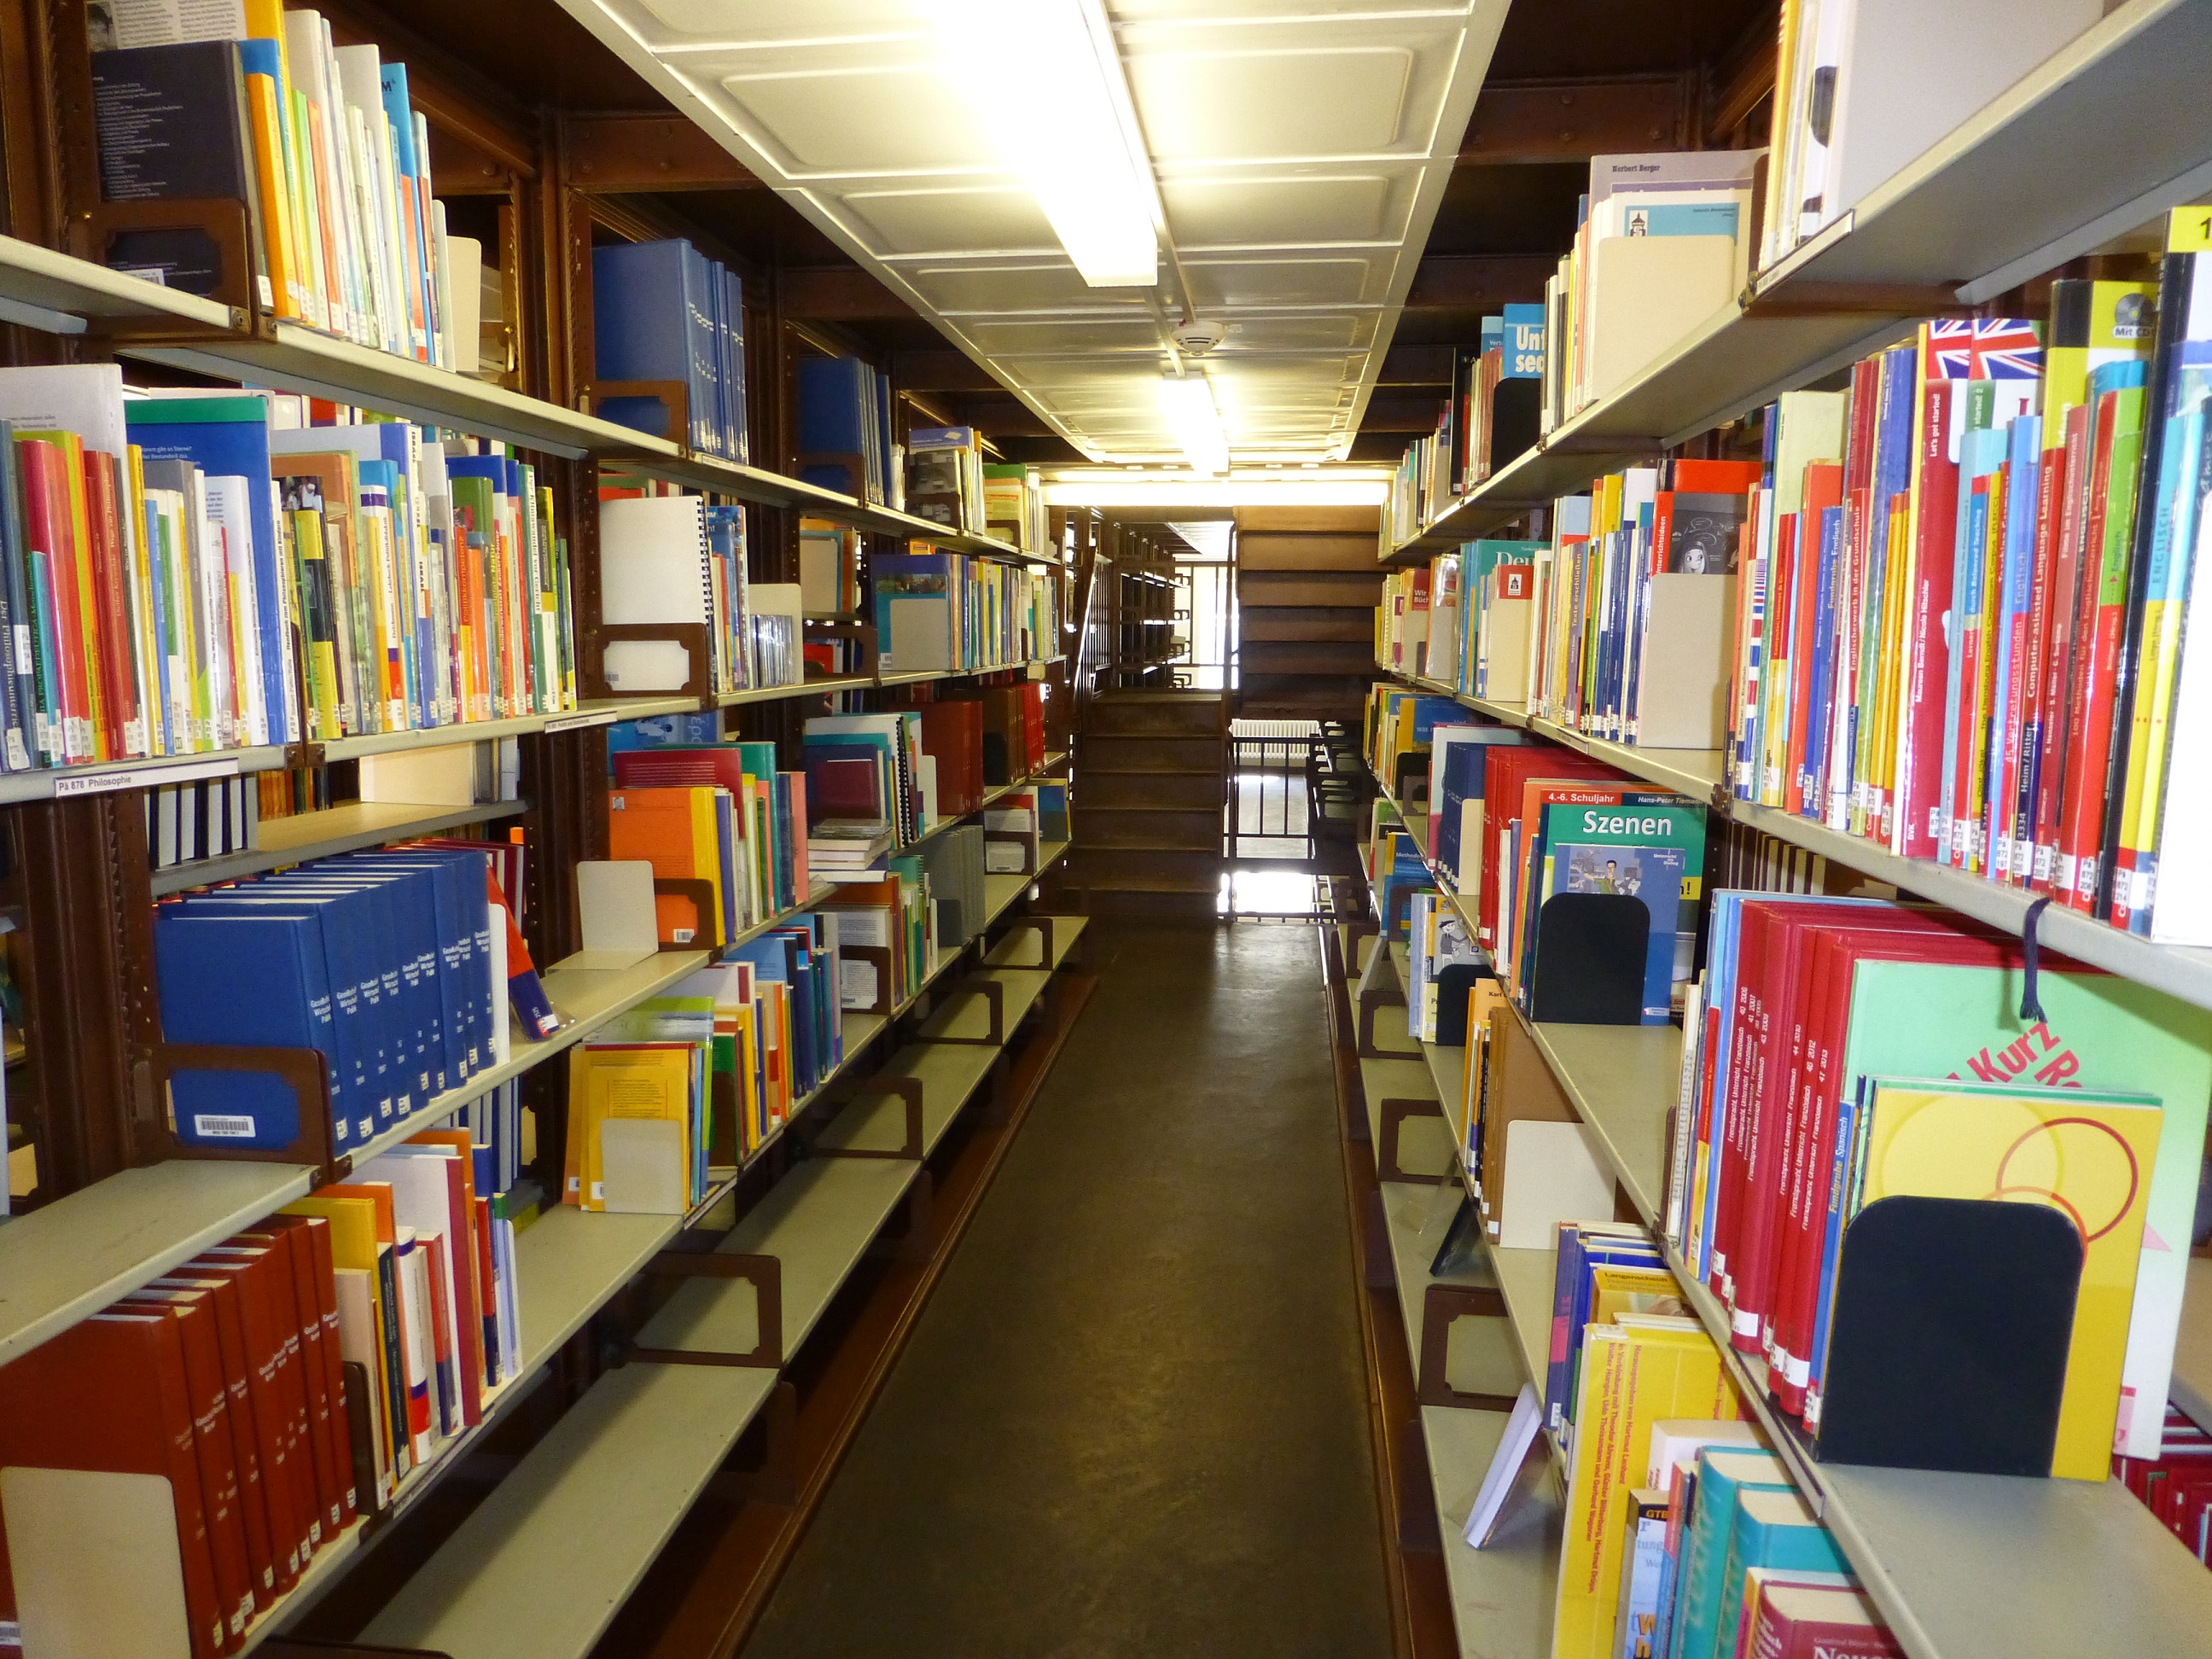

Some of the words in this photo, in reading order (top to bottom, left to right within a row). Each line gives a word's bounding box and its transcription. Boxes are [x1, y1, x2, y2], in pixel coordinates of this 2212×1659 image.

[1639, 164, 1661, 172] Berger
[2115, 328, 2133, 336] Mit
[1931, 393, 1940, 422] started!
[1973, 394, 1982, 424] started!
[1930, 438, 1938, 457] Let's
[2039, 465, 2052, 520] Learning
[528, 494, 538, 556] Klimawandel
[1852, 505, 1860, 565] Grundschule
[1973, 508, 1982, 545] Teaching
[2078, 486, 2089, 551] ENGLISCH
[1831, 519, 1841, 555] Englisch
[2034, 522, 2049, 582] Language
[2061, 532, 2070, 558] Filme
[2110, 530, 2124, 572] Englisch
[2149, 506, 2172, 584] ENGLISCH
[278, 557, 288, 603] Philosophieren
[457, 534, 469, 621] Politikkompetenz
[1572, 553, 1582, 602] erschließen
[1826, 558, 1838, 608] Fundgrube
[1970, 548, 1979, 586] Balanced
[0, 601, 9, 620] Der
[2074, 663, 2085, 714] Methoden
[2083, 523, 2098, 619] Englischunterricht
[1848, 598, 1859, 670] Englischerwerb
[1914, 669, 1924, 702] Maureen
[1920, 579, 1930, 613] Hitschler
[2005, 620, 2023, 744] Vertretungsstunden
[2014, 551, 2028, 604] Englisch
[0, 624, 19, 729] Philosophieunterric
[2023, 726, 2033, 757] Ritter
[58, 782, 70, 791] Pä
[72, 780, 85, 790] 878
[89, 775, 131, 789] Philosophie
[2020, 764, 2029, 792] Heim
[1548, 794, 1569, 802] 4.-6.
[1570, 794, 1615, 802] Schuljahr
[1582, 811, 1672, 836] Szenen
[2017, 812, 2026, 839] 3334
[2081, 870, 2093, 879] 872
[1734, 1027, 1743, 1063] Französisch
[1743, 1034, 1752, 1072] Französisch
[1966, 1022, 2062, 1084] Kurz
[1732, 1067, 1740, 1097] Unterricht
[1739, 1075, 1749, 1106] Unterricht
[1755, 1057, 1765, 1097] Französisch
[1786, 1068, 1796, 1109] Französisch
[1751, 1100, 1761, 1133] Unterricht
[1799, 1085, 1811, 1127] Französisch
[1783, 1112, 1792, 1146] Unterricht
[1807, 1142, 1817, 1179] Unterricht
[1812, 1095, 1823, 1138] Französisch
[1834, 1116, 1848, 1157] Spanisch
[1795, 1131, 1806, 1166] Unterricht
[1827, 1160, 1843, 1214] Fundgrube
[1604, 1272, 1668, 1283] Langenscheidt
[1606, 1342, 1615, 1366] Walter
[1612, 1351, 1625, 1394] Verbindung
[1627, 1344, 1642, 1404] Herausgegeben
[1608, 1411, 1618, 1441] Theodor
[1623, 1421, 1633, 1452] Hartmut
[1619, 1454, 1629, 1484] Lenhard
[1590, 1479, 1599, 1508] Gerhard
[1646, 1509, 1668, 1519] GTB
